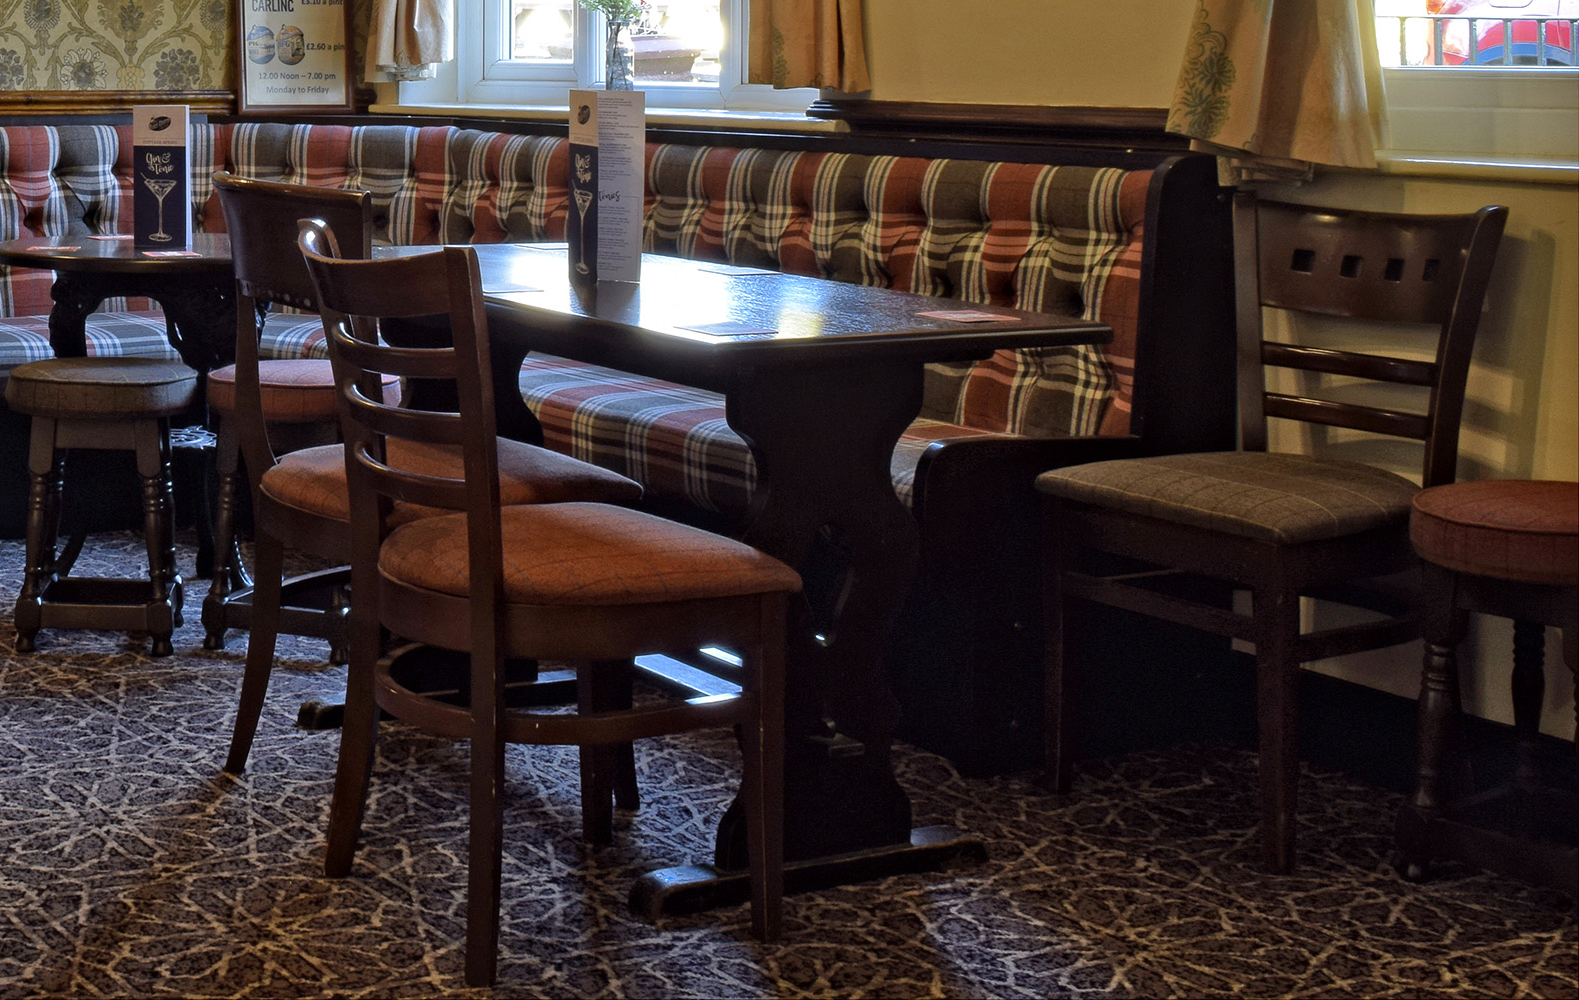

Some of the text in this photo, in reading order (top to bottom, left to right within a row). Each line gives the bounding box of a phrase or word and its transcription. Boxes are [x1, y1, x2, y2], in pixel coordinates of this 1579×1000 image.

[306, 43, 326, 51] £2.60
[333, 42, 345, 52] pin
[258, 72, 279, 80] 12.00
[280, 72, 299, 80] Noon
[307, 72, 323, 80] 7.00
[324, 73, 336, 81] pm
[266, 86, 329, 95] Monday to Friday
[146, 152, 161, 164] Gin
